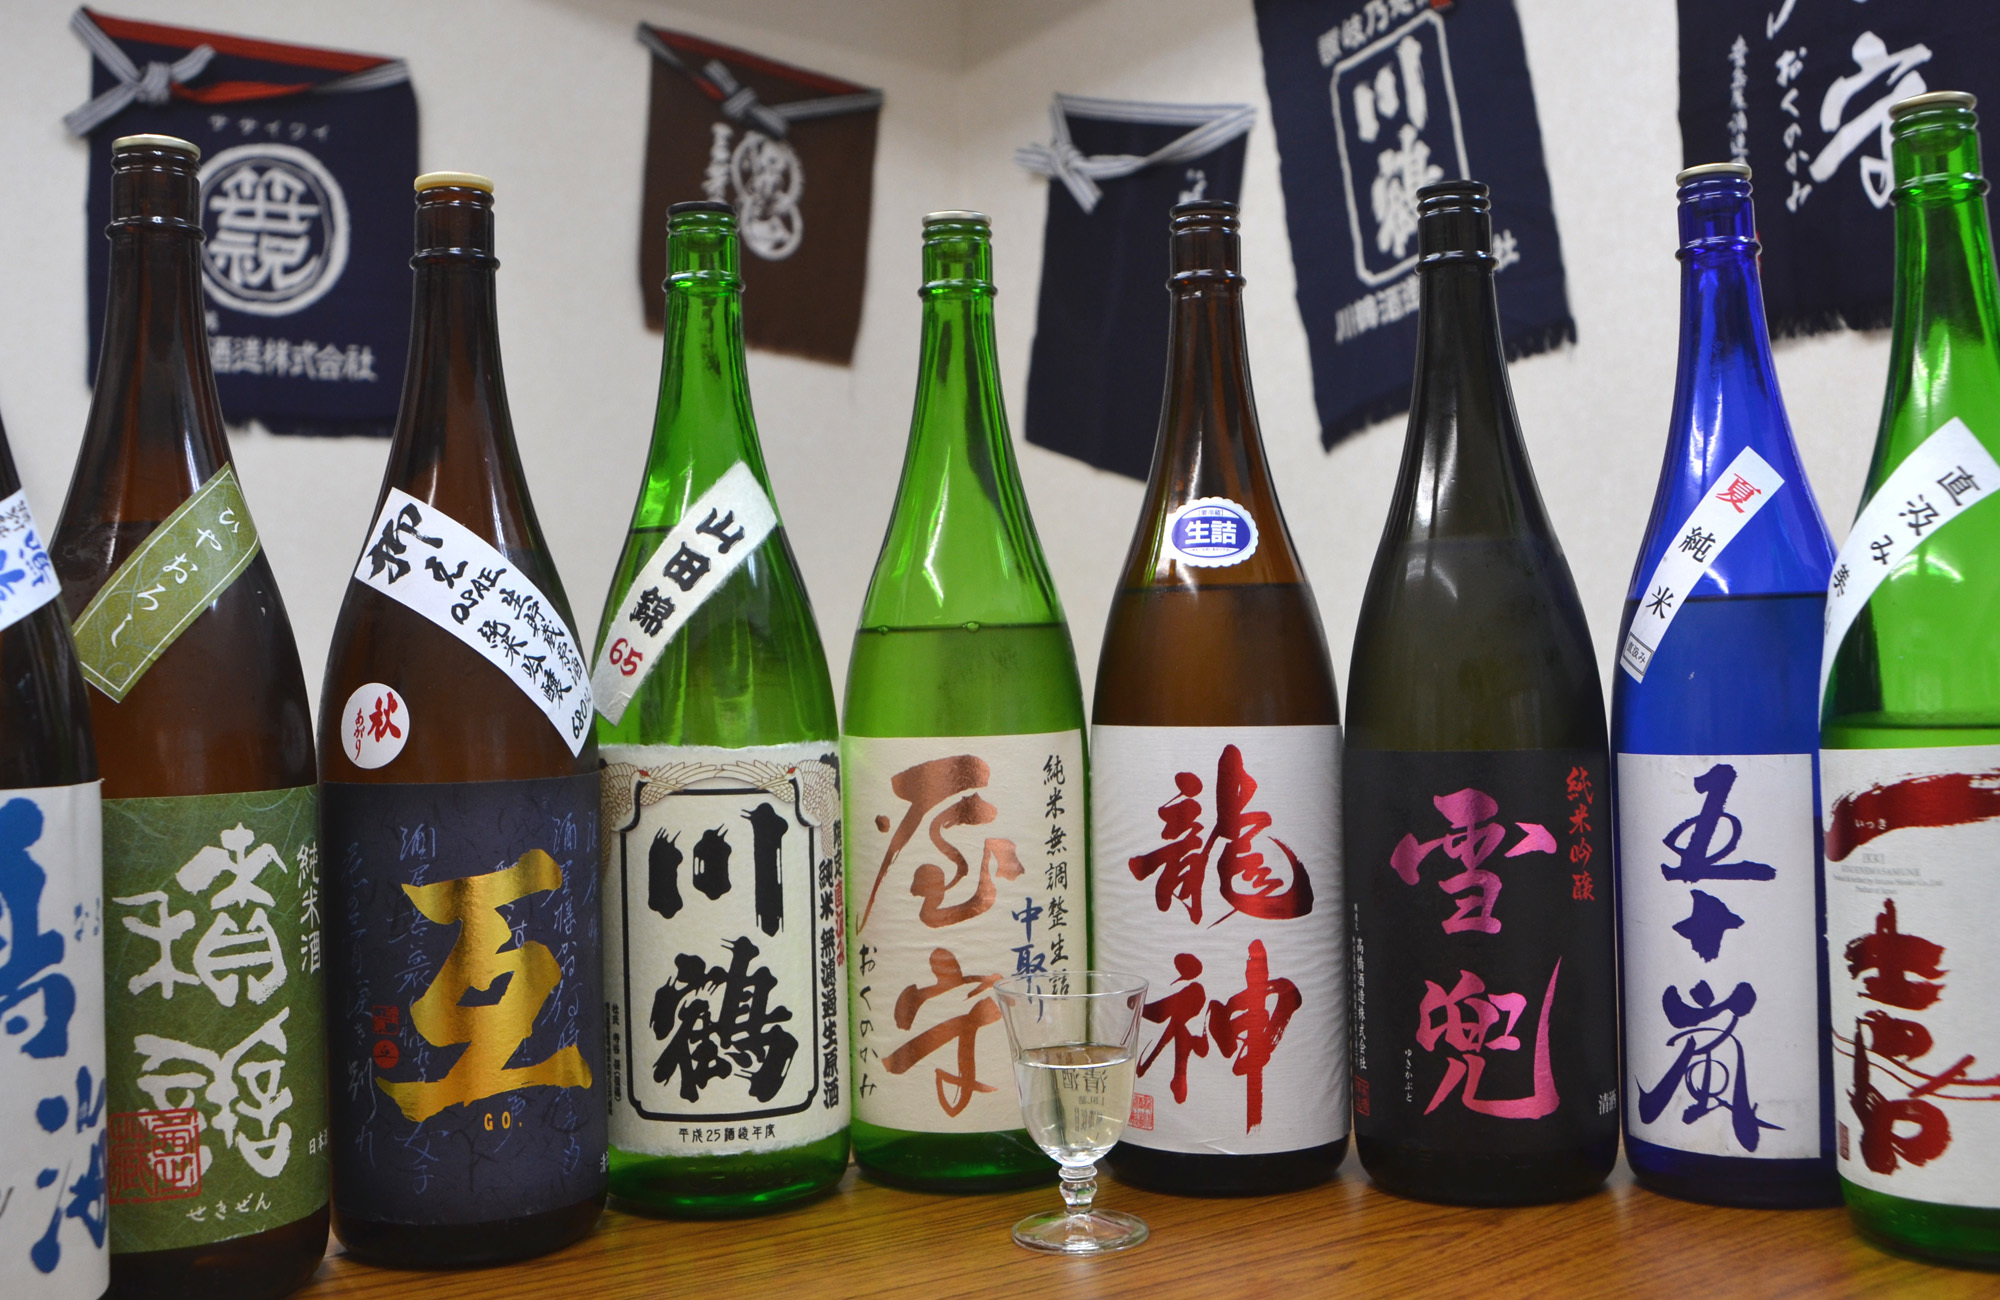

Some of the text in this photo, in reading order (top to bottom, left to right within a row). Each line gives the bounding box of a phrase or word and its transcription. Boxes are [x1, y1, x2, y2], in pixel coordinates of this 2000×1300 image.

[111, 506, 240, 648] ひやおろし
[451, 567, 507, 625] OSAE
[609, 506, 746, 678] 山田錦 65
[1184, 520, 1237, 545] 生詰
[1566, 766, 1595, 901] 純米吟醸
[296, 841, 322, 976] 純米酒
[647, 802, 799, 1102] 川鶴
[1011, 897, 1048, 1023] 中取り
[1128, 744, 1315, 1135] 龍神
[1635, 763, 1786, 1153] 五十嵐
[859, 943, 878, 1100] おくのかみ
[1404, 1048, 1413, 1103] ゆきかぶと
[678, 1124, 776, 1143] 平成25酒造年度
[186, 1192, 271, 1222] せきぜん
